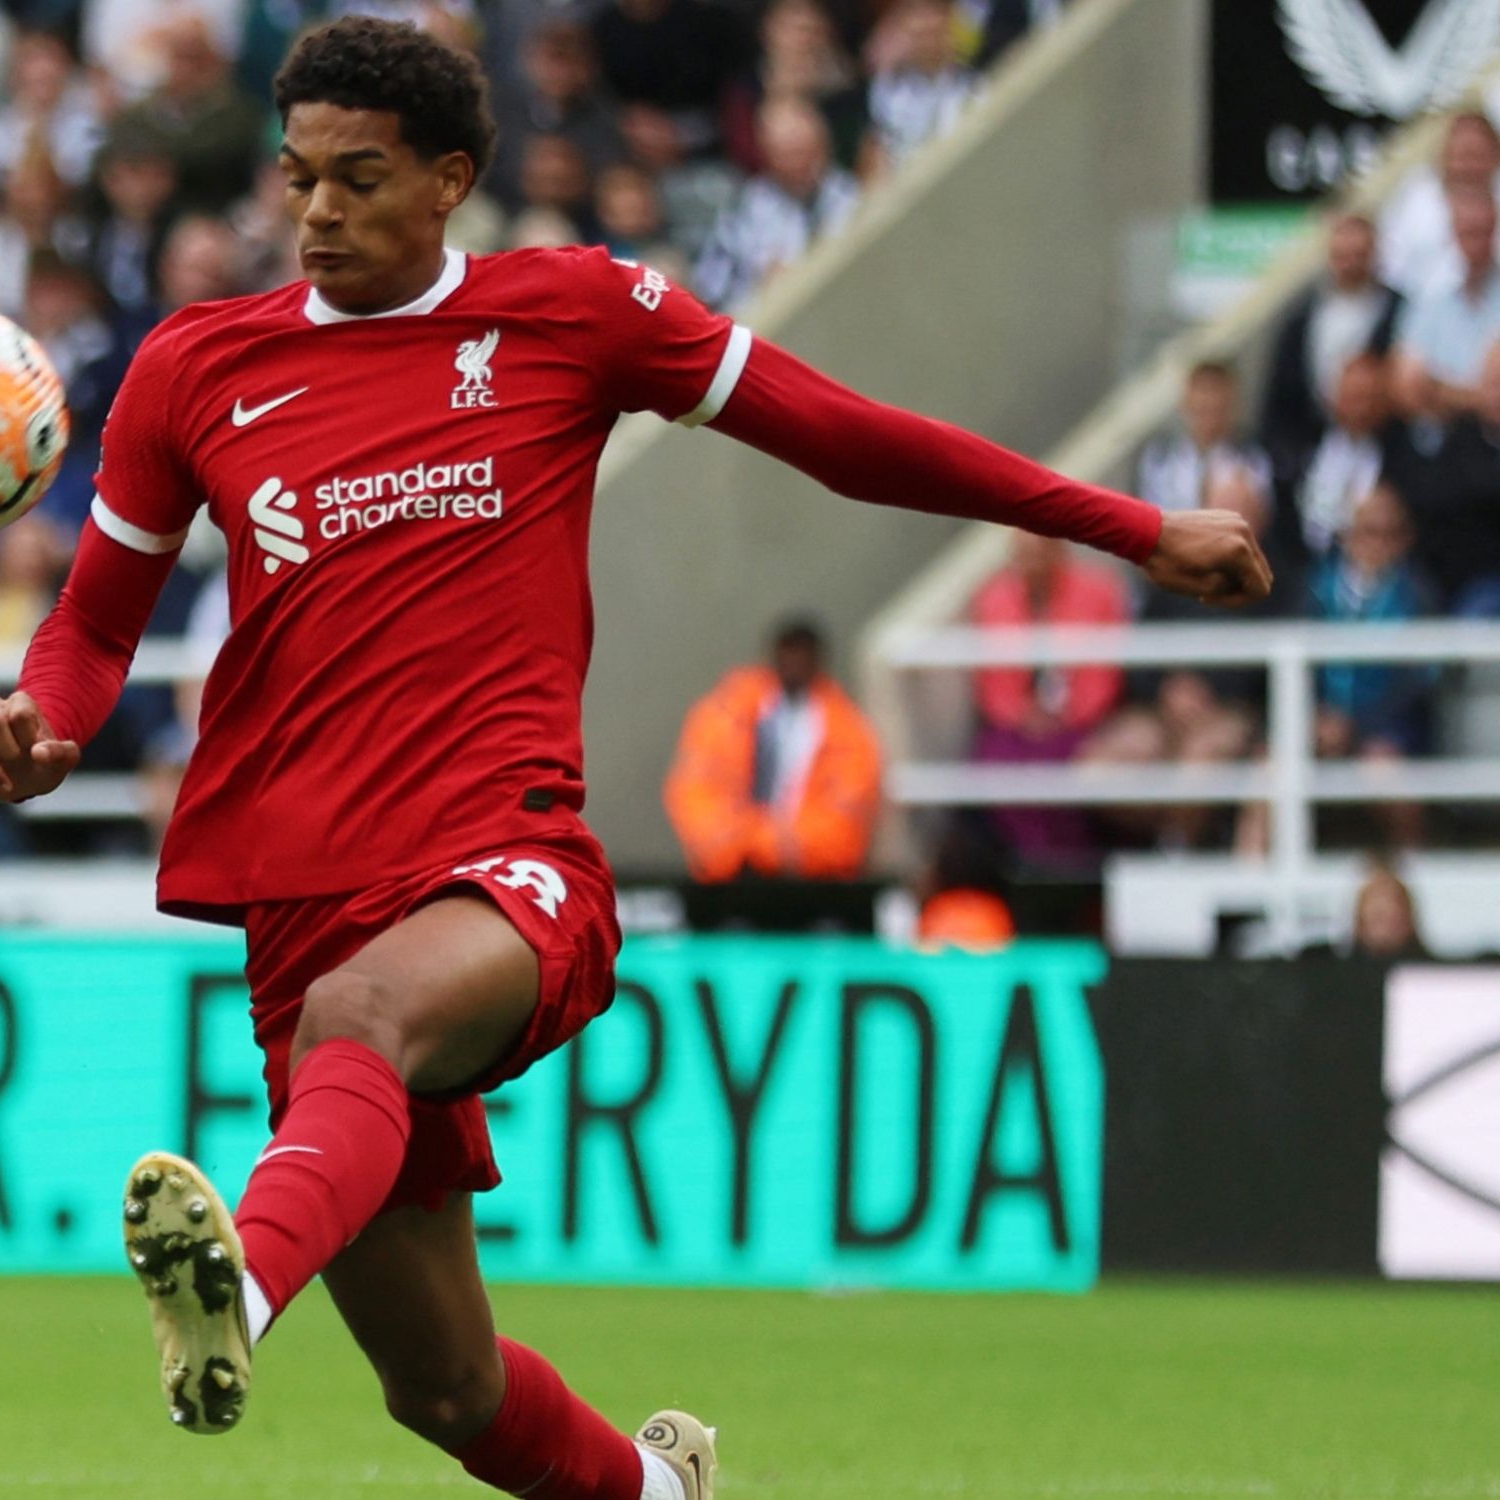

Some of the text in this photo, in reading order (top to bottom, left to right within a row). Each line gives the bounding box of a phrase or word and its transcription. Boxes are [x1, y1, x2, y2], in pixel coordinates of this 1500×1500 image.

[315, 456, 493, 509] standard
[320, 489, 503, 539] chartered
[185, 972, 1102, 1254] ERYDA
